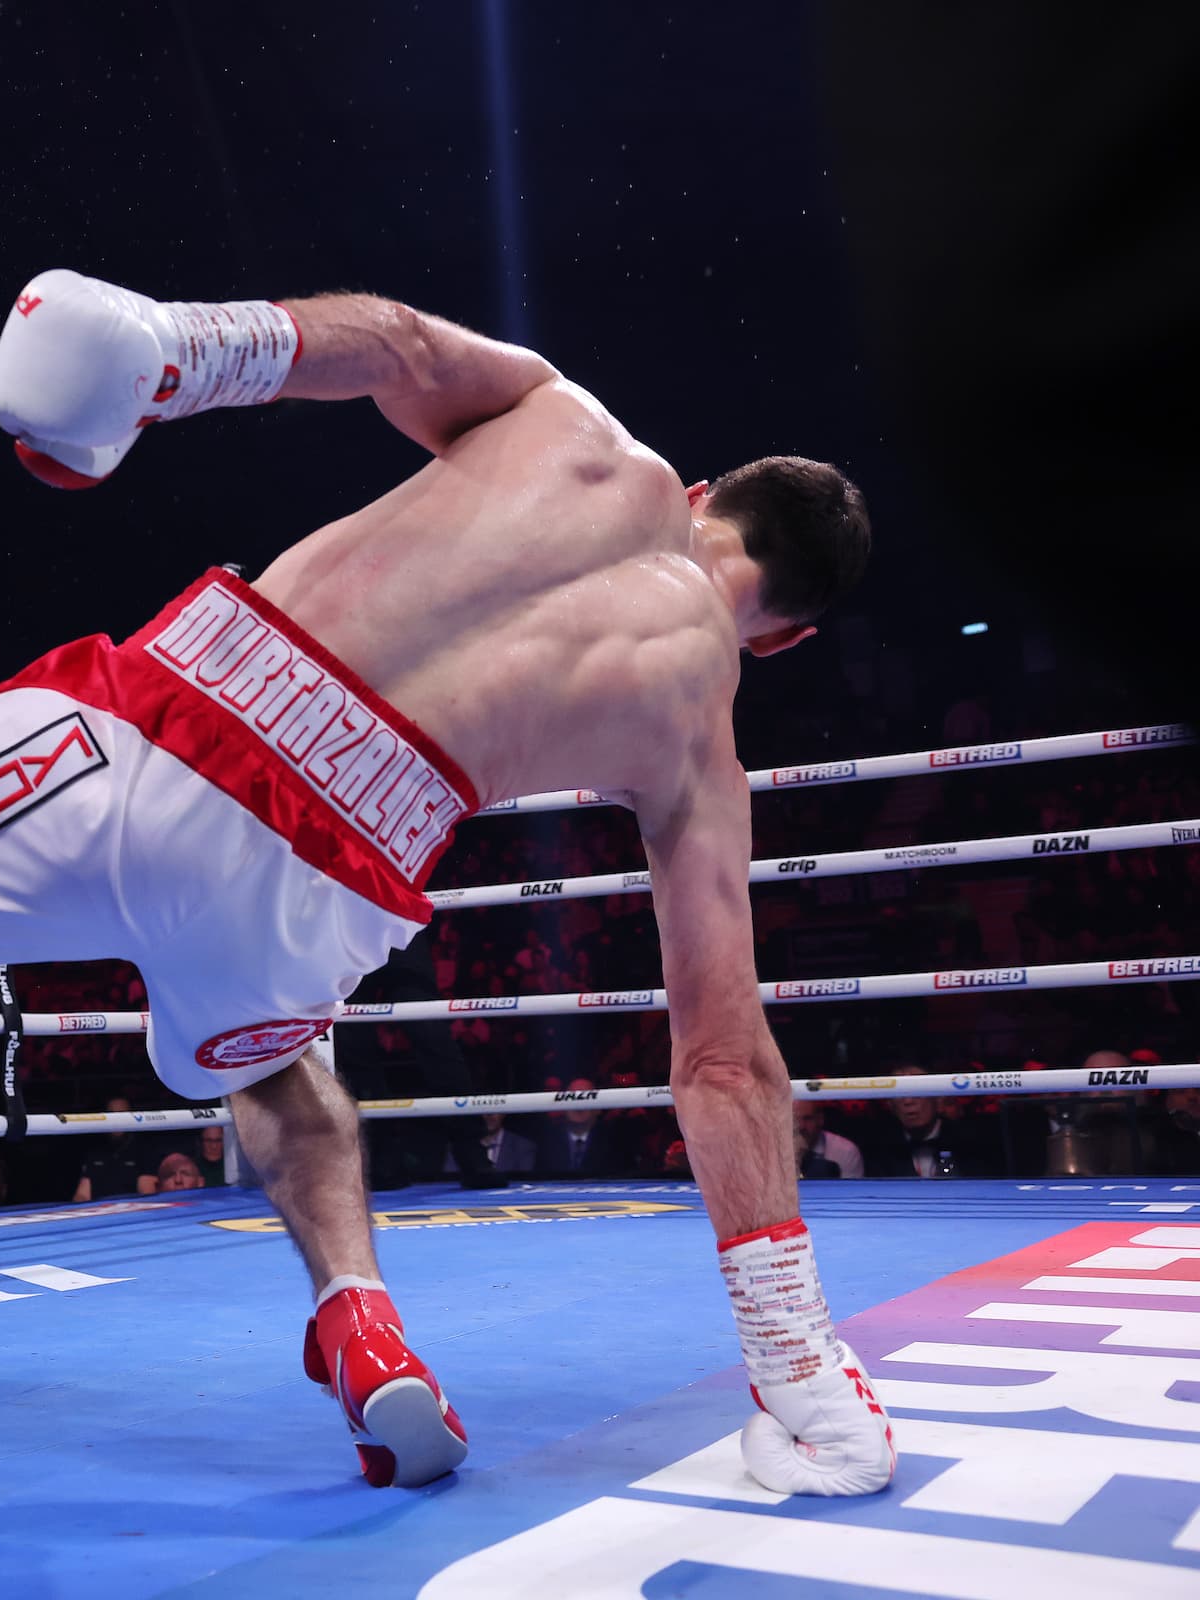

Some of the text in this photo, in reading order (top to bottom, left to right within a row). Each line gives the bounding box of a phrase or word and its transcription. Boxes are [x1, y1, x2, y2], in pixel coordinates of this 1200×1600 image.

[1106, 726, 1188, 746] BETFRE
[932, 745, 1020, 766] BETFRED
[774, 763, 853, 784] BETFRED
[1032, 835, 1090, 854] DAZN
[884, 847, 957, 860] MATCHROOM
[778, 858, 817, 874] drip
[519, 882, 563, 897] DAZN
[937, 970, 1024, 988] BETFRED
[778, 979, 859, 998] BETFRED
[451, 997, 518, 1010] BETFRED
[581, 991, 652, 1006] BETFRED
[62, 1015, 106, 1029] BETFRED
[975, 1080, 1022, 1089] SEASON
[1088, 1070, 1149, 1087] DAZN
[471, 1098, 507, 1107] SEASON
